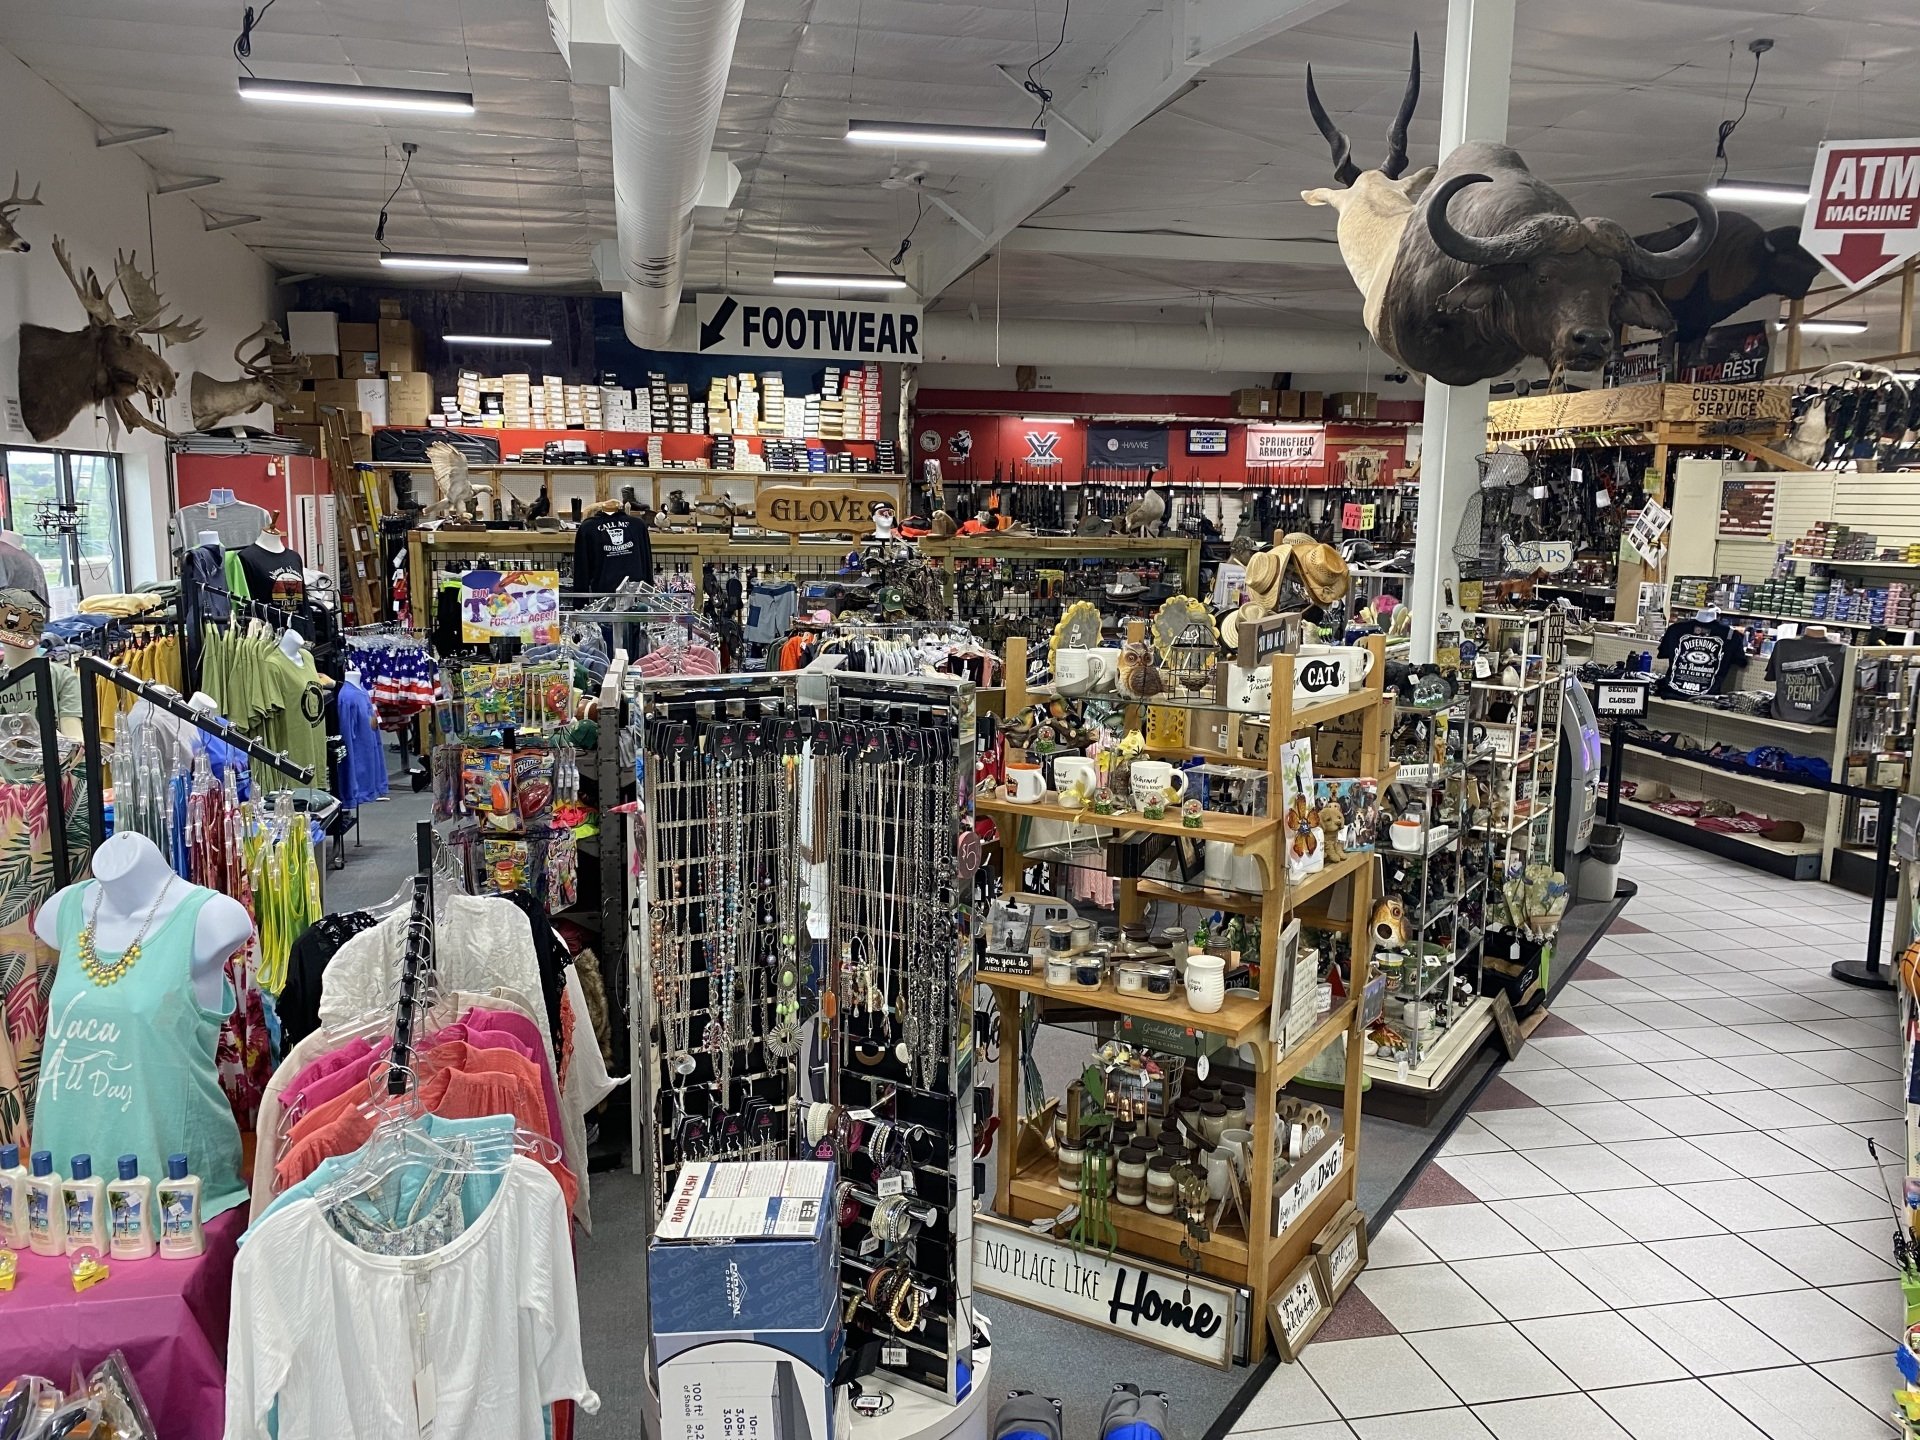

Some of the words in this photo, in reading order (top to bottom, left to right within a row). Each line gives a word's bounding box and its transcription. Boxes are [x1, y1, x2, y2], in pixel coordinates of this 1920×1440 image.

[1826, 155, 1920, 200] ATM
[1825, 204, 1912, 221] MACHINE
[743, 306, 919, 355] FOOTWEAR
[1692, 388, 1765, 402] CUSTOMER
[1698, 402, 1758, 416] SERVICE
[1121, 441, 1149, 449] HAWKE
[1259, 436, 1315, 446] SPRINGFIELD
[1259, 447, 1293, 457] ARMORY
[1296, 446, 1312, 456] USA
[597, 521, 616, 531] CALL
[1517, 550, 1566, 562] MAPS
[472, 588, 489, 598] FUN
[490, 616, 506, 626] FOR
[510, 614, 527, 625] ALL
[1683, 639, 1719, 652] DEFENDING
[1308, 666, 1334, 685] CAT
[1682, 682, 1700, 691] NRA
[1787, 685, 1821, 701] PERMIT
[1794, 702, 1811, 710] NRA
[961, 841, 977, 871] $5
[1002, 957, 1017, 970] you
[1018, 957, 1029, 967] do
[48, 990, 120, 1042] Vaca
[36, 1039, 85, 1103] All
[88, 1069, 132, 1112] Day
[671, 1198, 690, 1223] RAPID
[684, 1175, 699, 1196] PUSH
[985, 1240, 1009, 1273] NO
[1014, 1248, 1056, 1289] PLACE
[1064, 1262, 1101, 1302] LIKE
[1108, 1267, 1222, 1339] Home
[684, 1385, 690, 1393] of
[693, 1382, 702, 1402] 100
[684, 1394, 692, 1416] Shade
